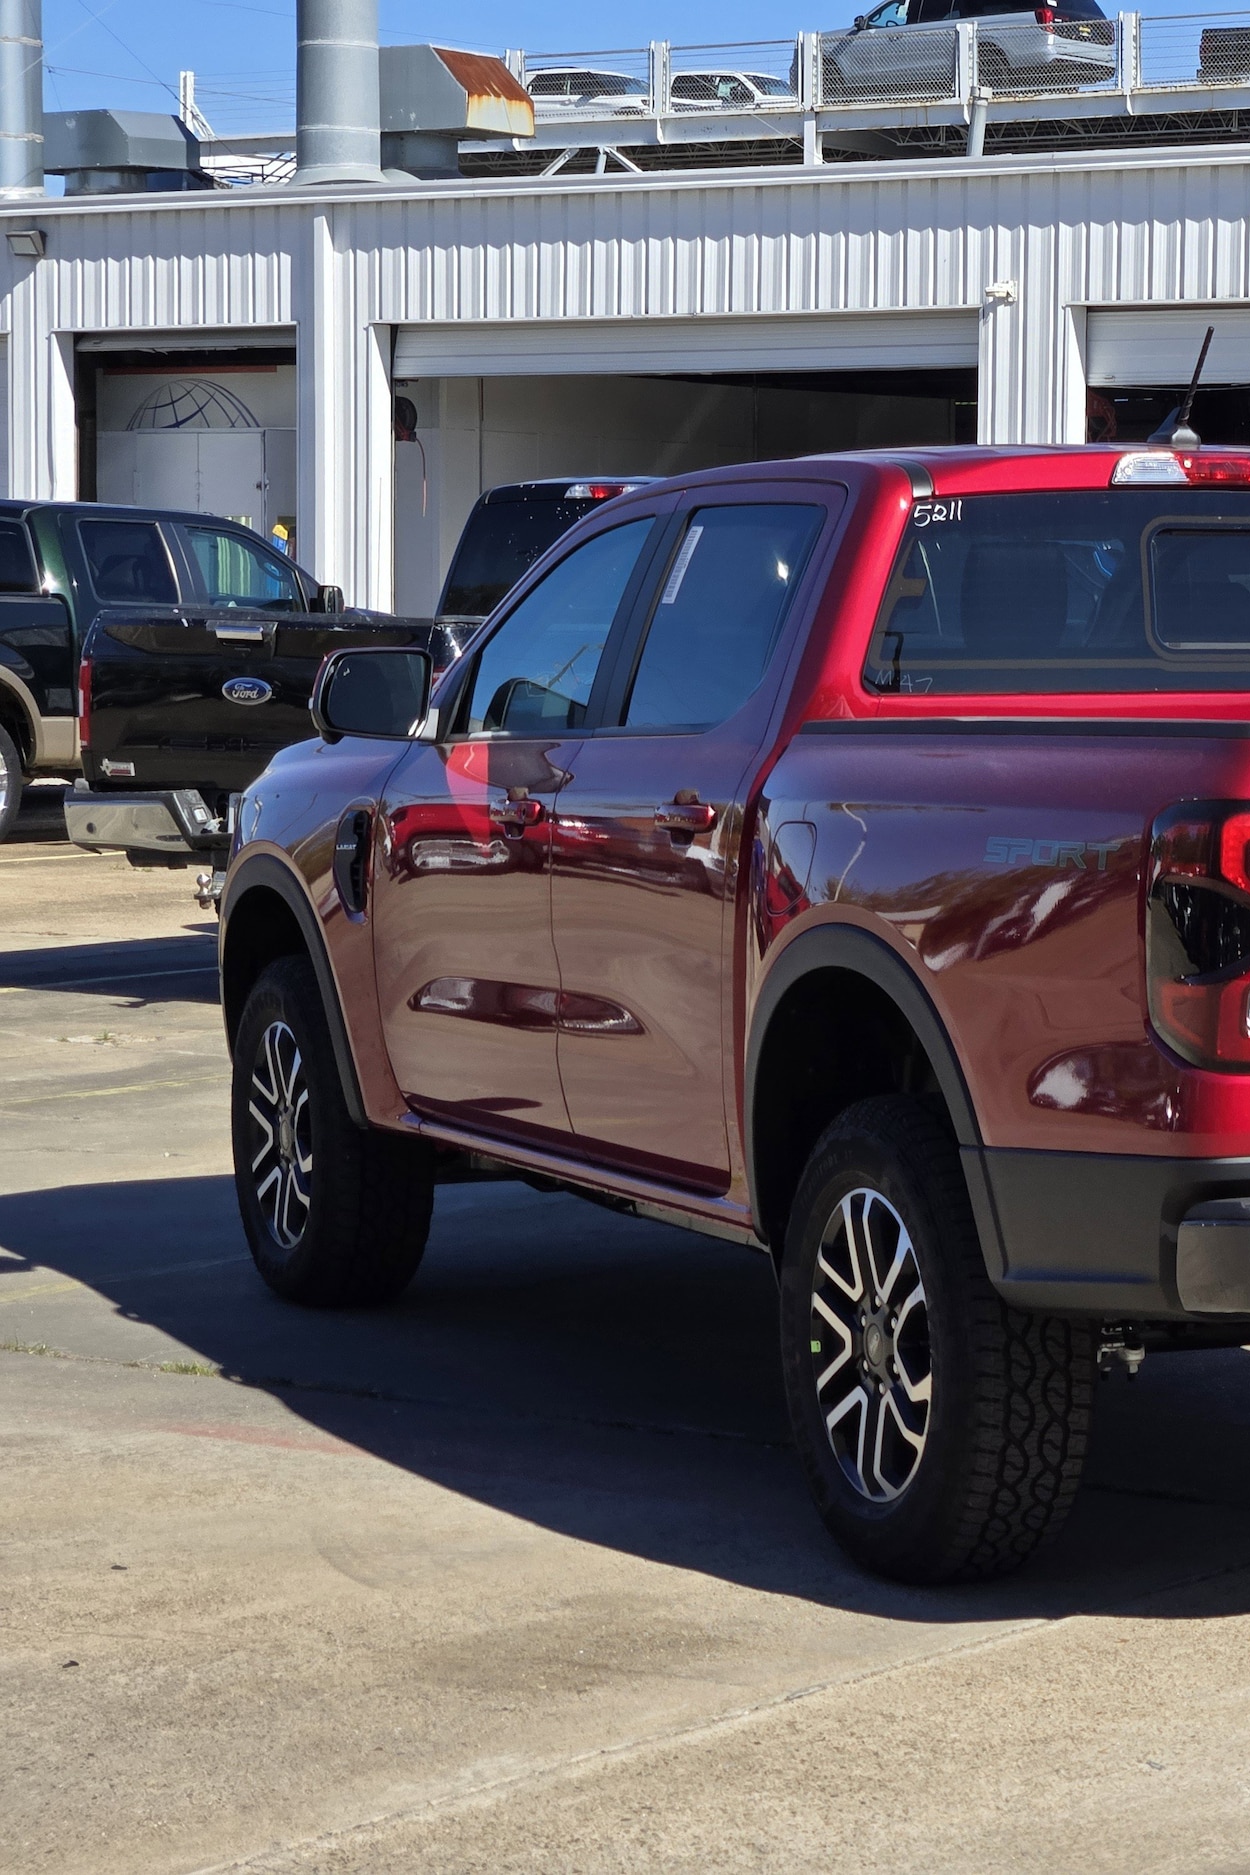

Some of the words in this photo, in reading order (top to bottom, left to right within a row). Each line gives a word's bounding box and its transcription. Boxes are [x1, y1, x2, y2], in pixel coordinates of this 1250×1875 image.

[914, 499, 962, 527] 5211
[232, 683, 259, 698] Ford
[983, 836, 1121, 871] SPORT
